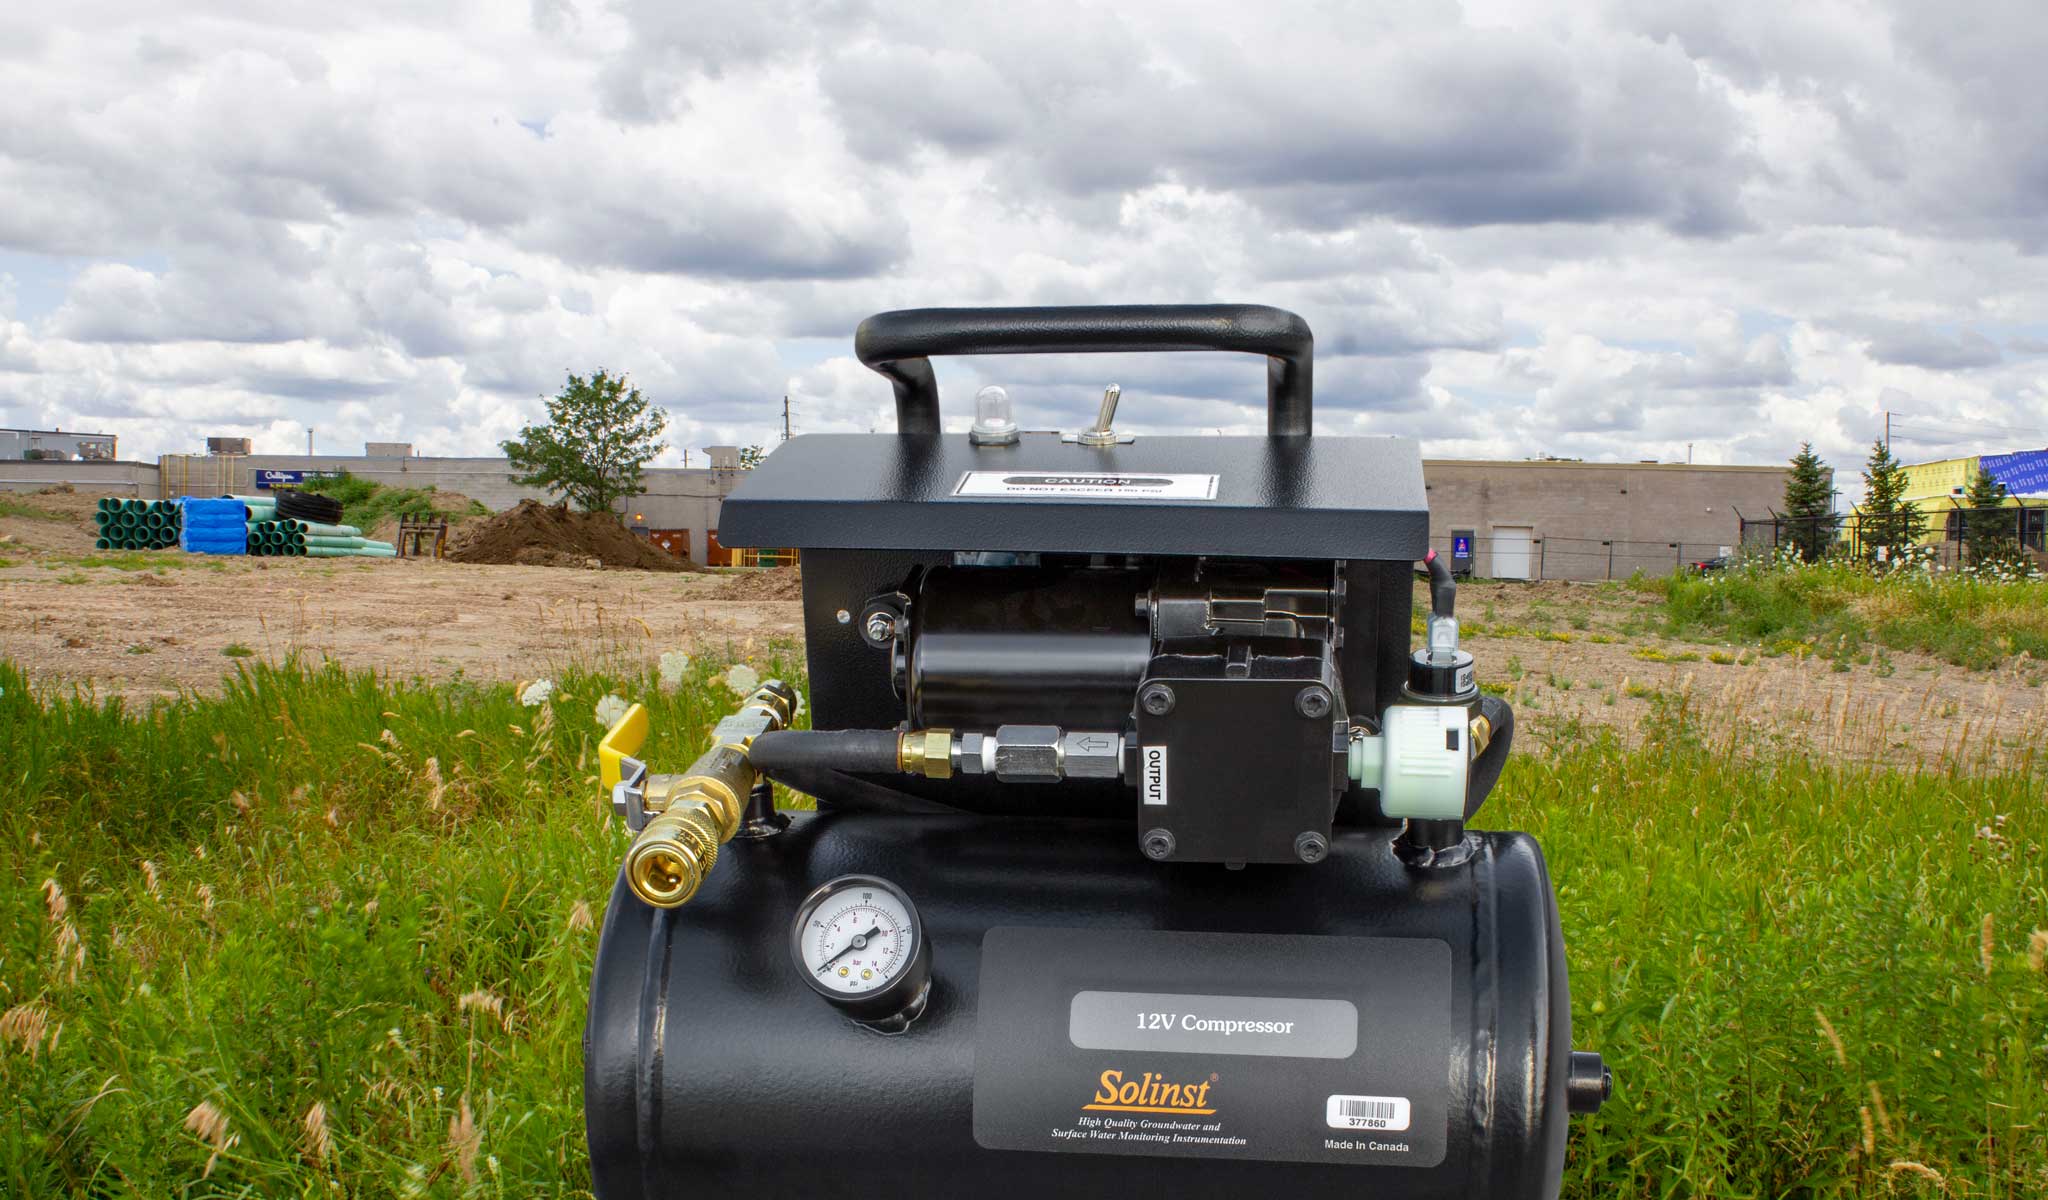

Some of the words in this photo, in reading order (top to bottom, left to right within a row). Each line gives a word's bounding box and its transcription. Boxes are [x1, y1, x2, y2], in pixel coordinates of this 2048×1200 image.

[1149, 750, 1161, 800] OUTPUT
[862, 892, 872, 900] 100
[882, 947, 889, 955] 12
[1136, 1012, 1176, 1030] 12V
[1181, 1014, 1294, 1036] Compressor
[1078, 1117, 1101, 1128] High
[1104, 1118, 1137, 1130] Quality
[1140, 1119, 1200, 1131] Groundwater
[1202, 1122, 1221, 1132] and
[1348, 1117, 1386, 1128] 377860
[1051, 1128, 1087, 1140] Surface
[1089, 1129, 1116, 1140] Water
[1118, 1131, 1170, 1144] Monitoring
[1172, 1133, 1247, 1145] Instrumentation
[1324, 1139, 1353, 1149] Made
[1355, 1140, 1366, 1150] In
[1368, 1141, 1409, 1152] Canada
